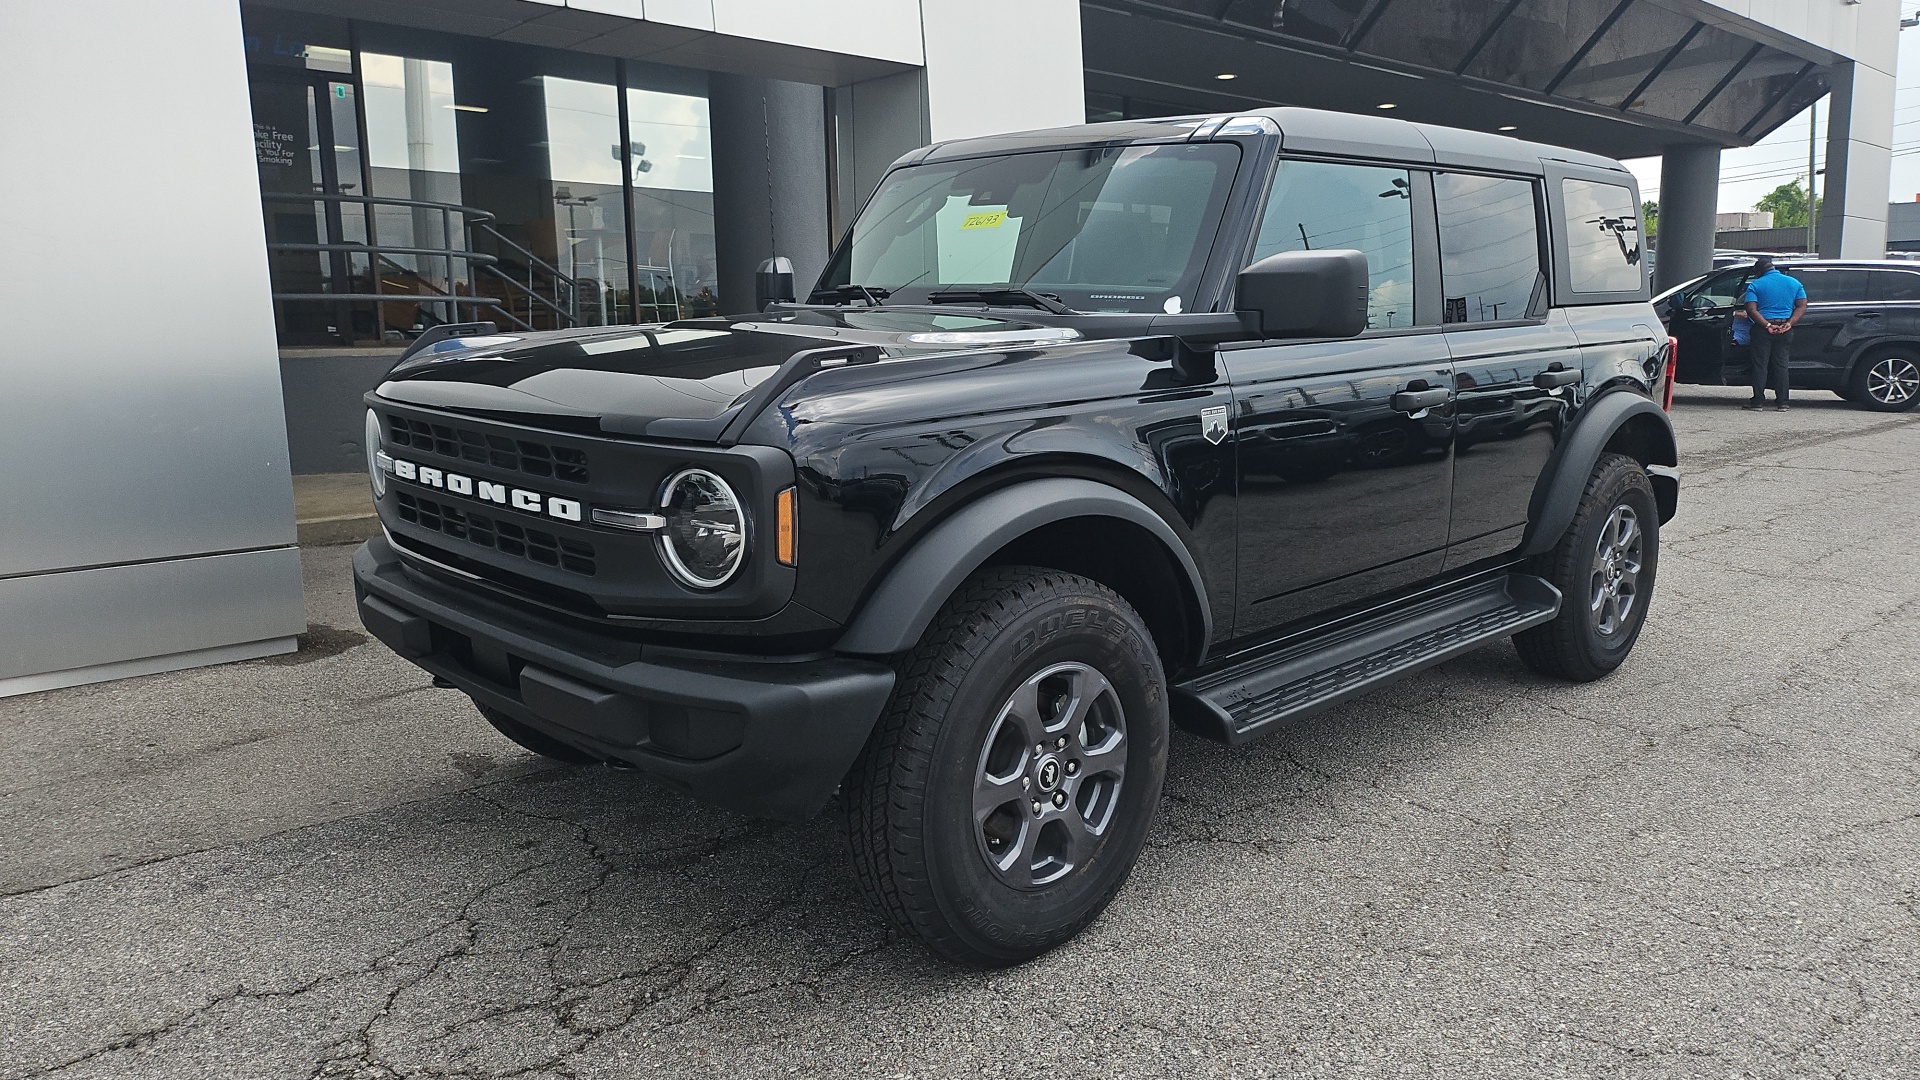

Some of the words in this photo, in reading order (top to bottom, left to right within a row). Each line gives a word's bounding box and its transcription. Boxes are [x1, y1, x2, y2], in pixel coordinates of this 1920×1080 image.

[254, 129, 269, 139] oke
[272, 131, 294, 141] Free
[255, 139, 282, 151] acility
[265, 149, 280, 157] You
[282, 150, 295, 158] For
[258, 155, 293, 167] Smoking
[394, 458, 582, 522] BRONCO
[1010, 607, 1143, 662] DUELER
